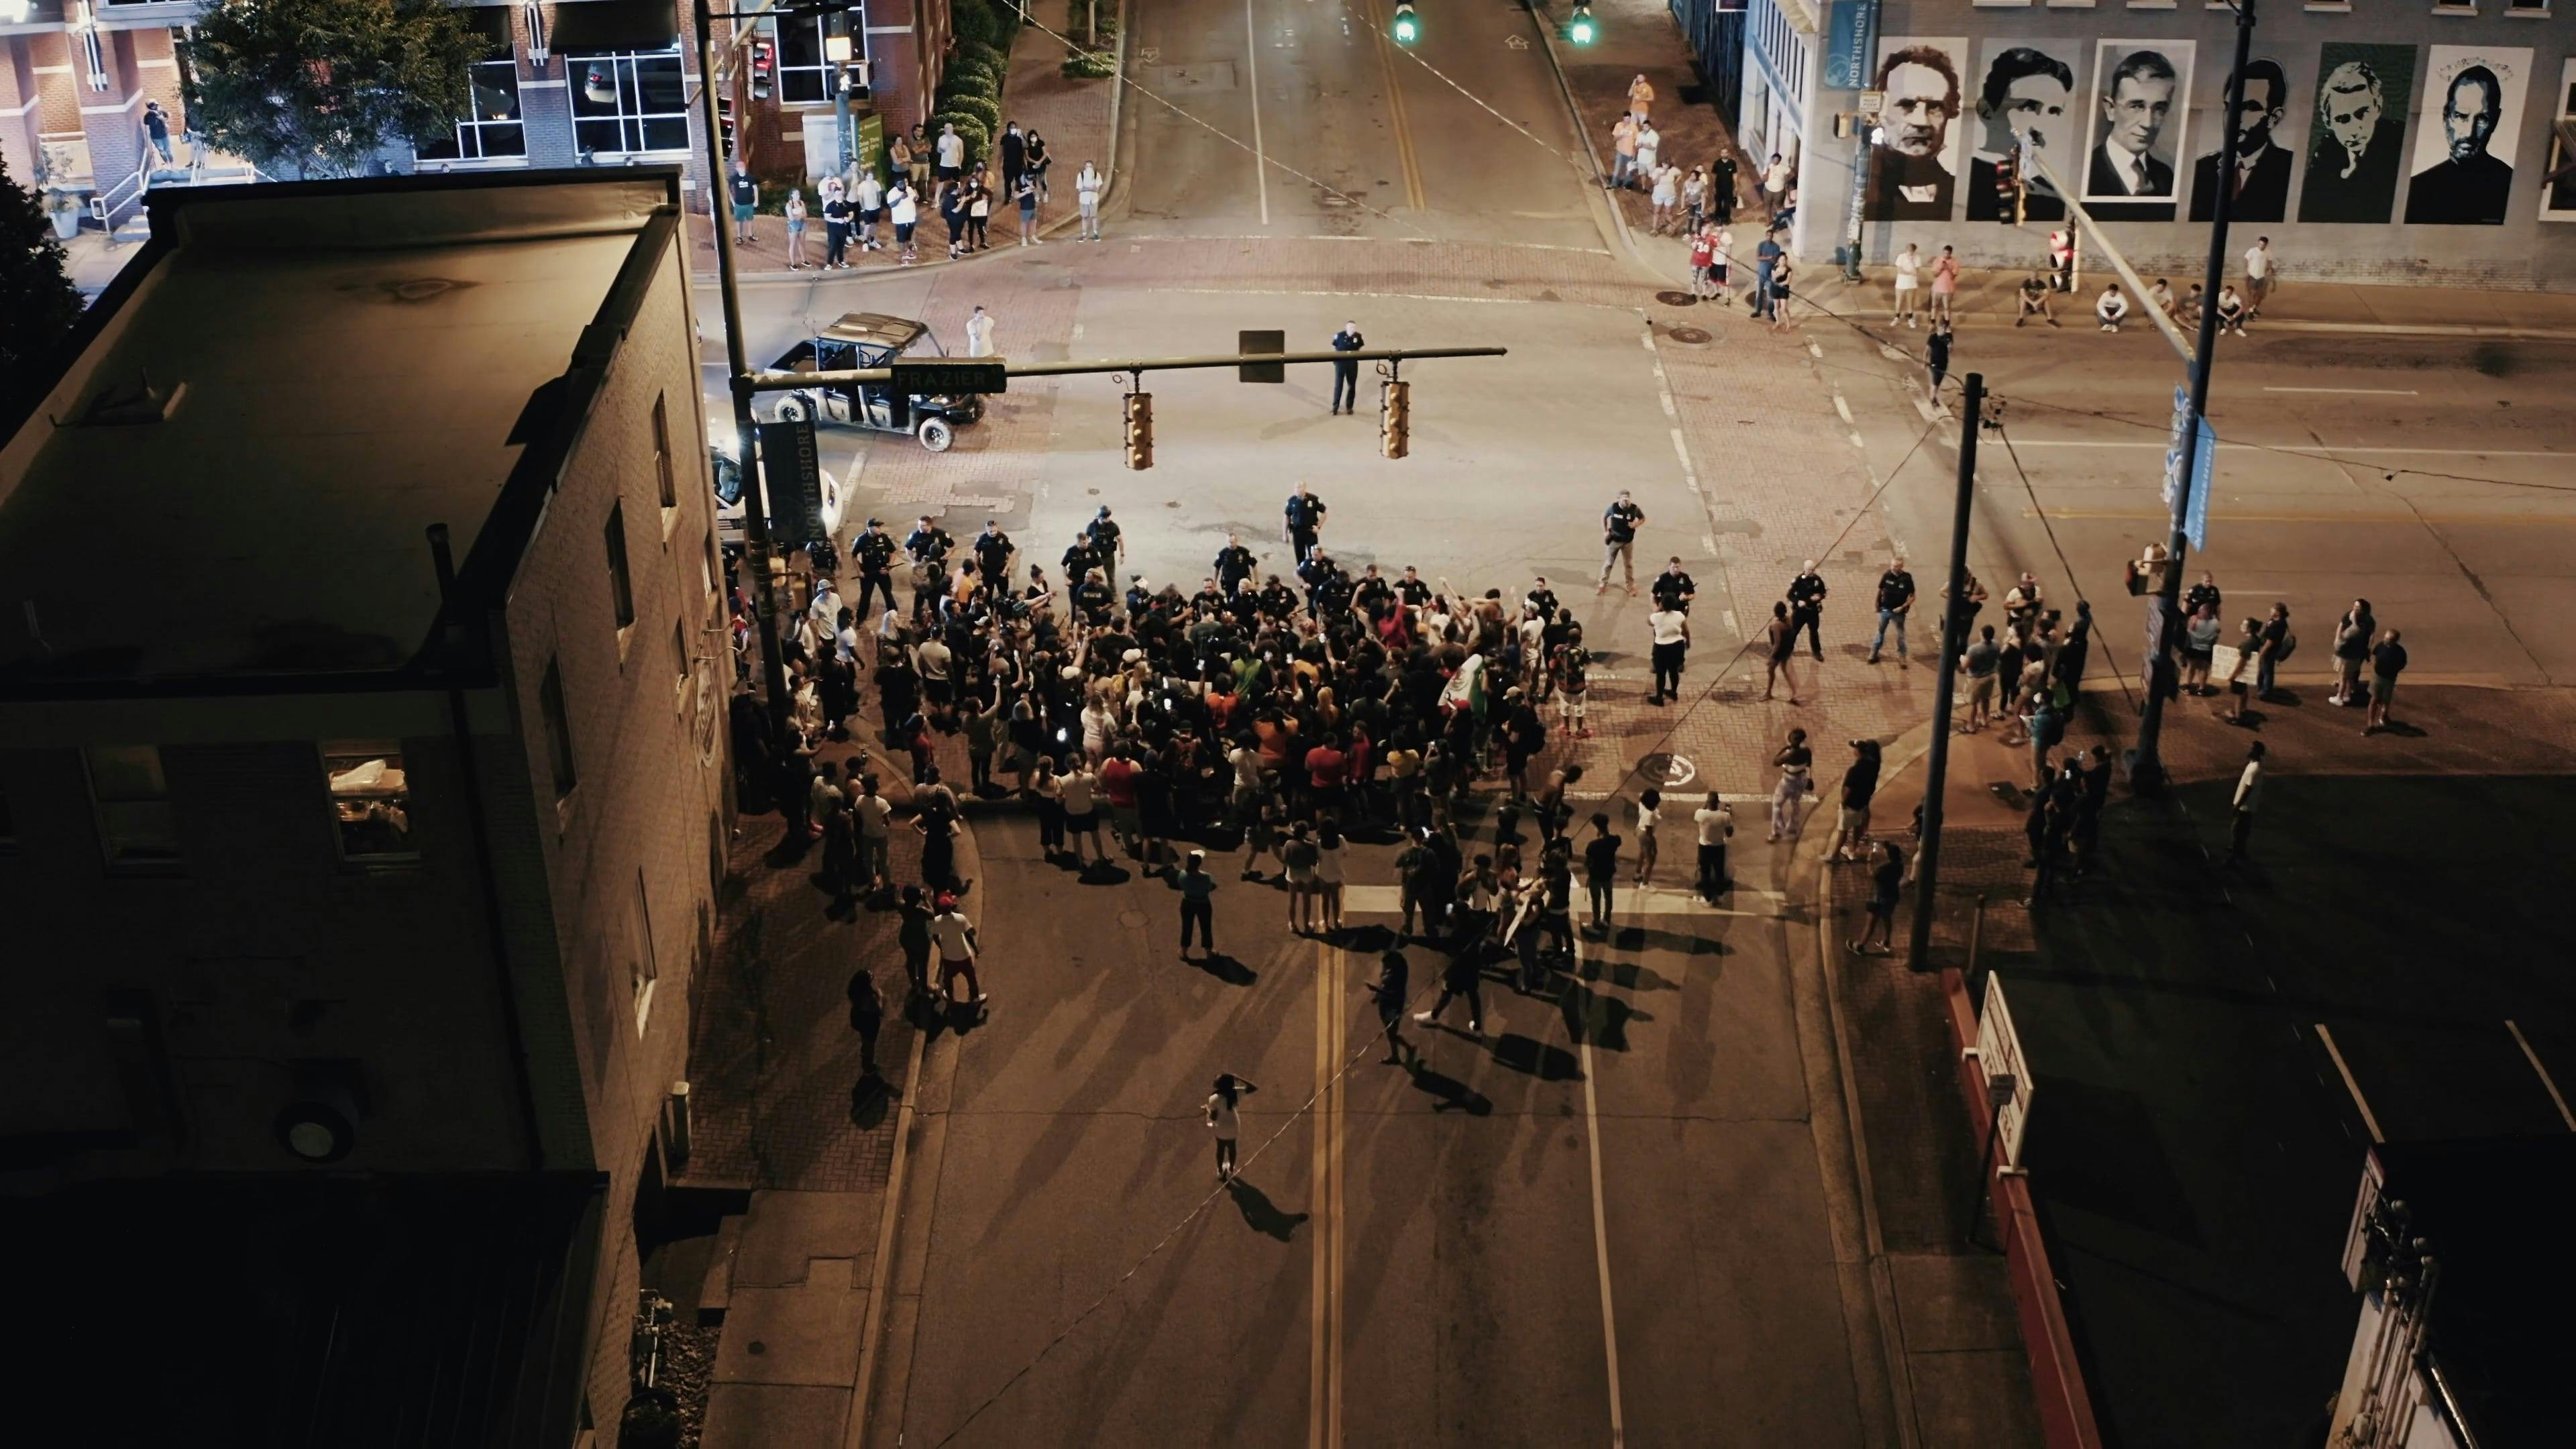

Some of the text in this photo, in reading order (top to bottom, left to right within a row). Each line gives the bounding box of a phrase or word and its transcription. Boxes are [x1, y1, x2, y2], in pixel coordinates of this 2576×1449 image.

[1848, 3, 1868, 87] NORTHSHORE
[896, 370, 985, 388] FRAZIER
[796, 424, 821, 539] NORTHSHORE
